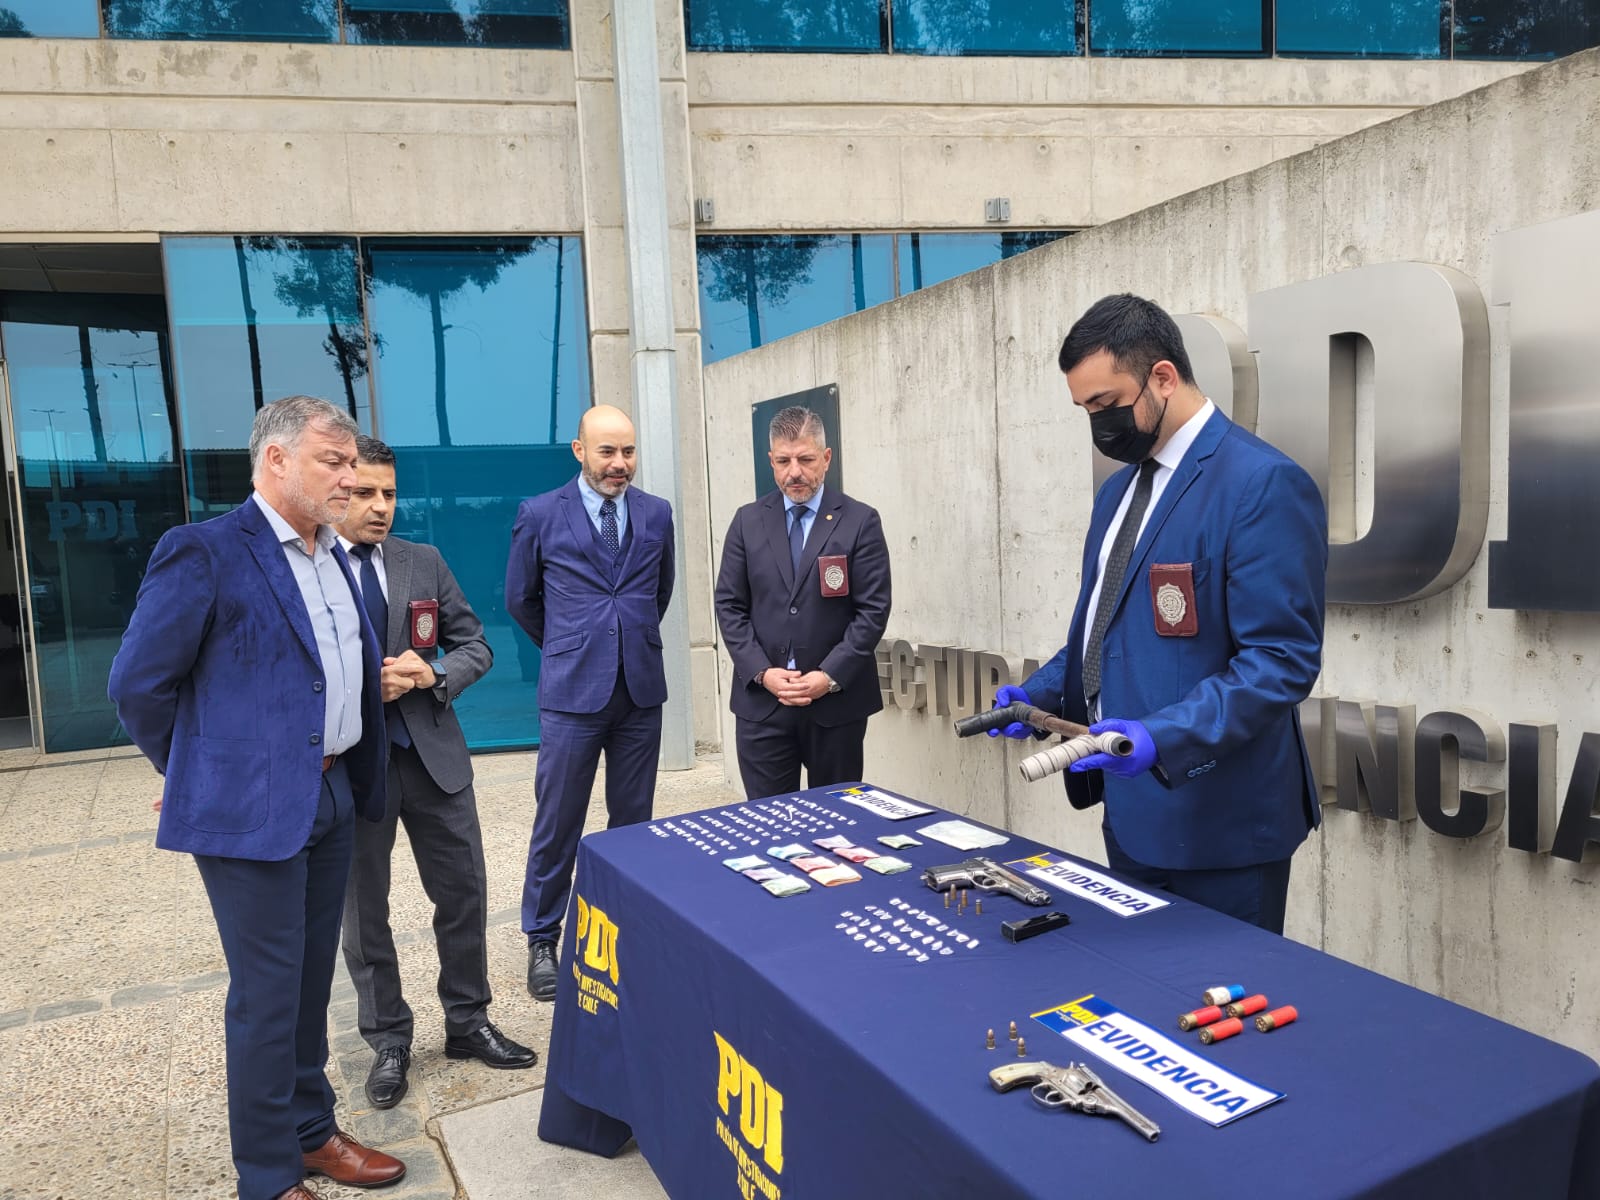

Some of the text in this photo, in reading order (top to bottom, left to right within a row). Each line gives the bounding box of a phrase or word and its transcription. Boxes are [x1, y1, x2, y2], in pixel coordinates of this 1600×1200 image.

[45, 500, 139, 541] PDI
[874, 638, 1046, 716] CTUR
[851, 793, 918, 817] EVIDENCIA
[1039, 864, 1151, 912] EVIDENCIA
[576, 894, 619, 986] PDI
[1060, 1003, 1101, 1025] PDI
[1081, 1020, 1252, 1115] EVIDENCIA
[713, 1030, 783, 1175] PDI
